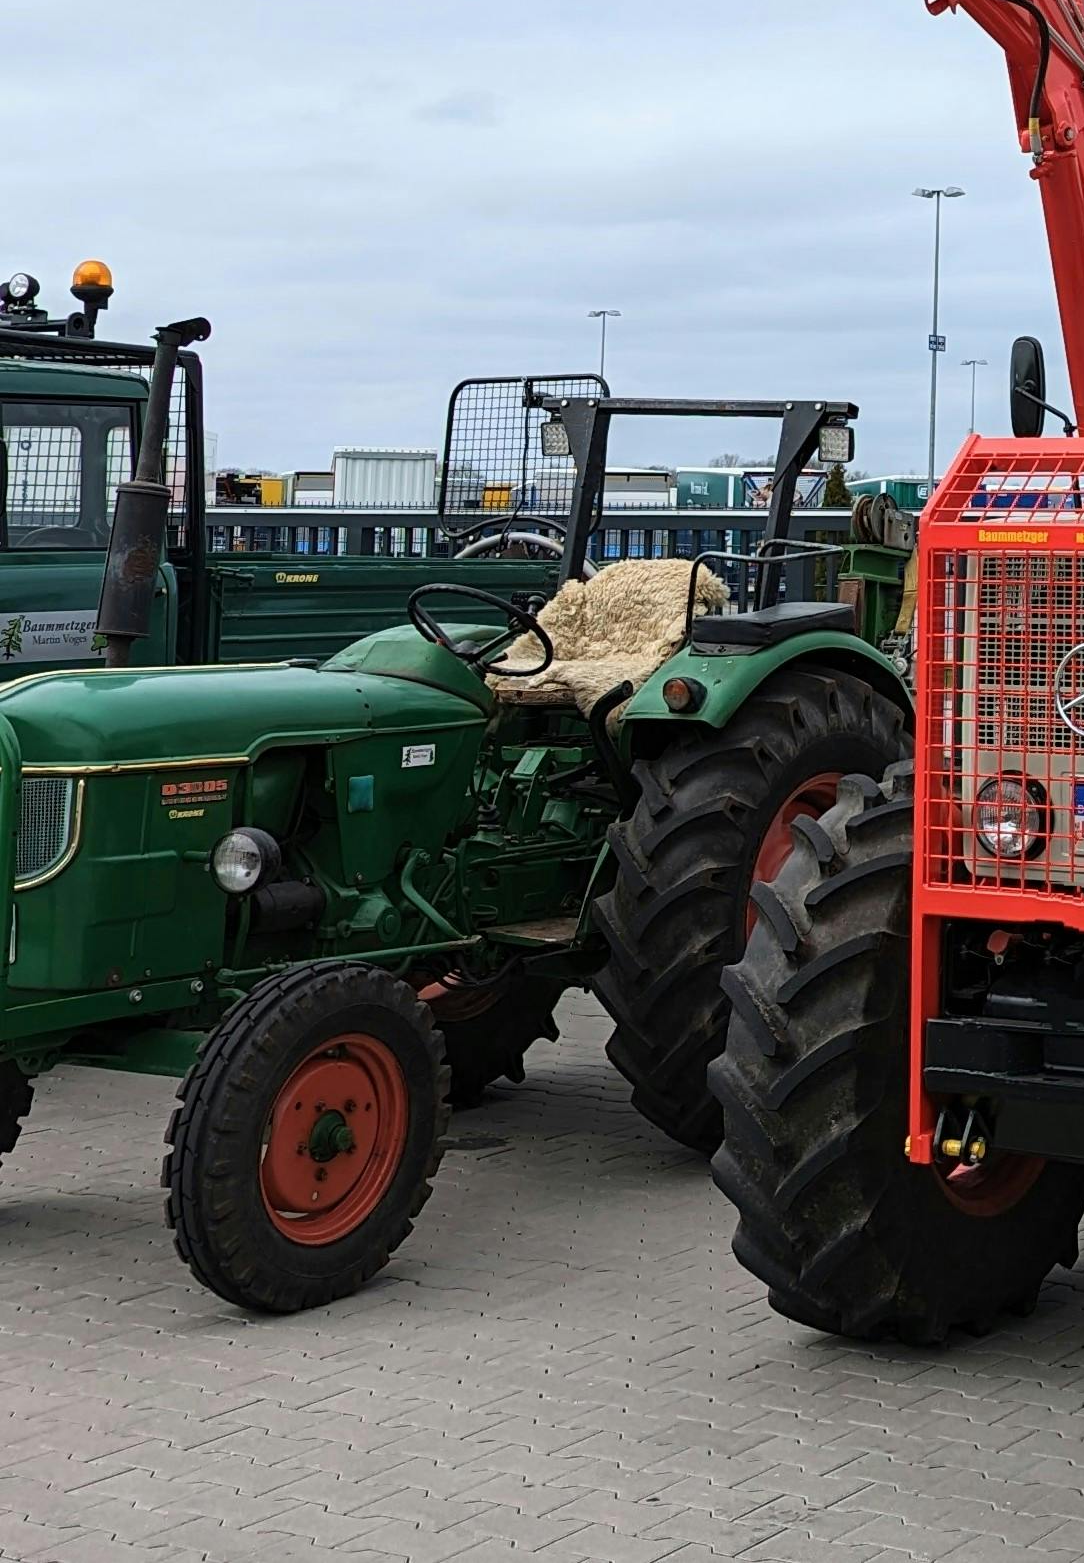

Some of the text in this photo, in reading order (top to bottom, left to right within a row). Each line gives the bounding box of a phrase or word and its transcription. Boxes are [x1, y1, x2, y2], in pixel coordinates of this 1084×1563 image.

[978, 529, 1048, 543] Baummetzger
[285, 574, 319, 583] KRONE
[23, 619, 97, 633] Baummetzger
[33, 634, 87, 646] Martin Voges
